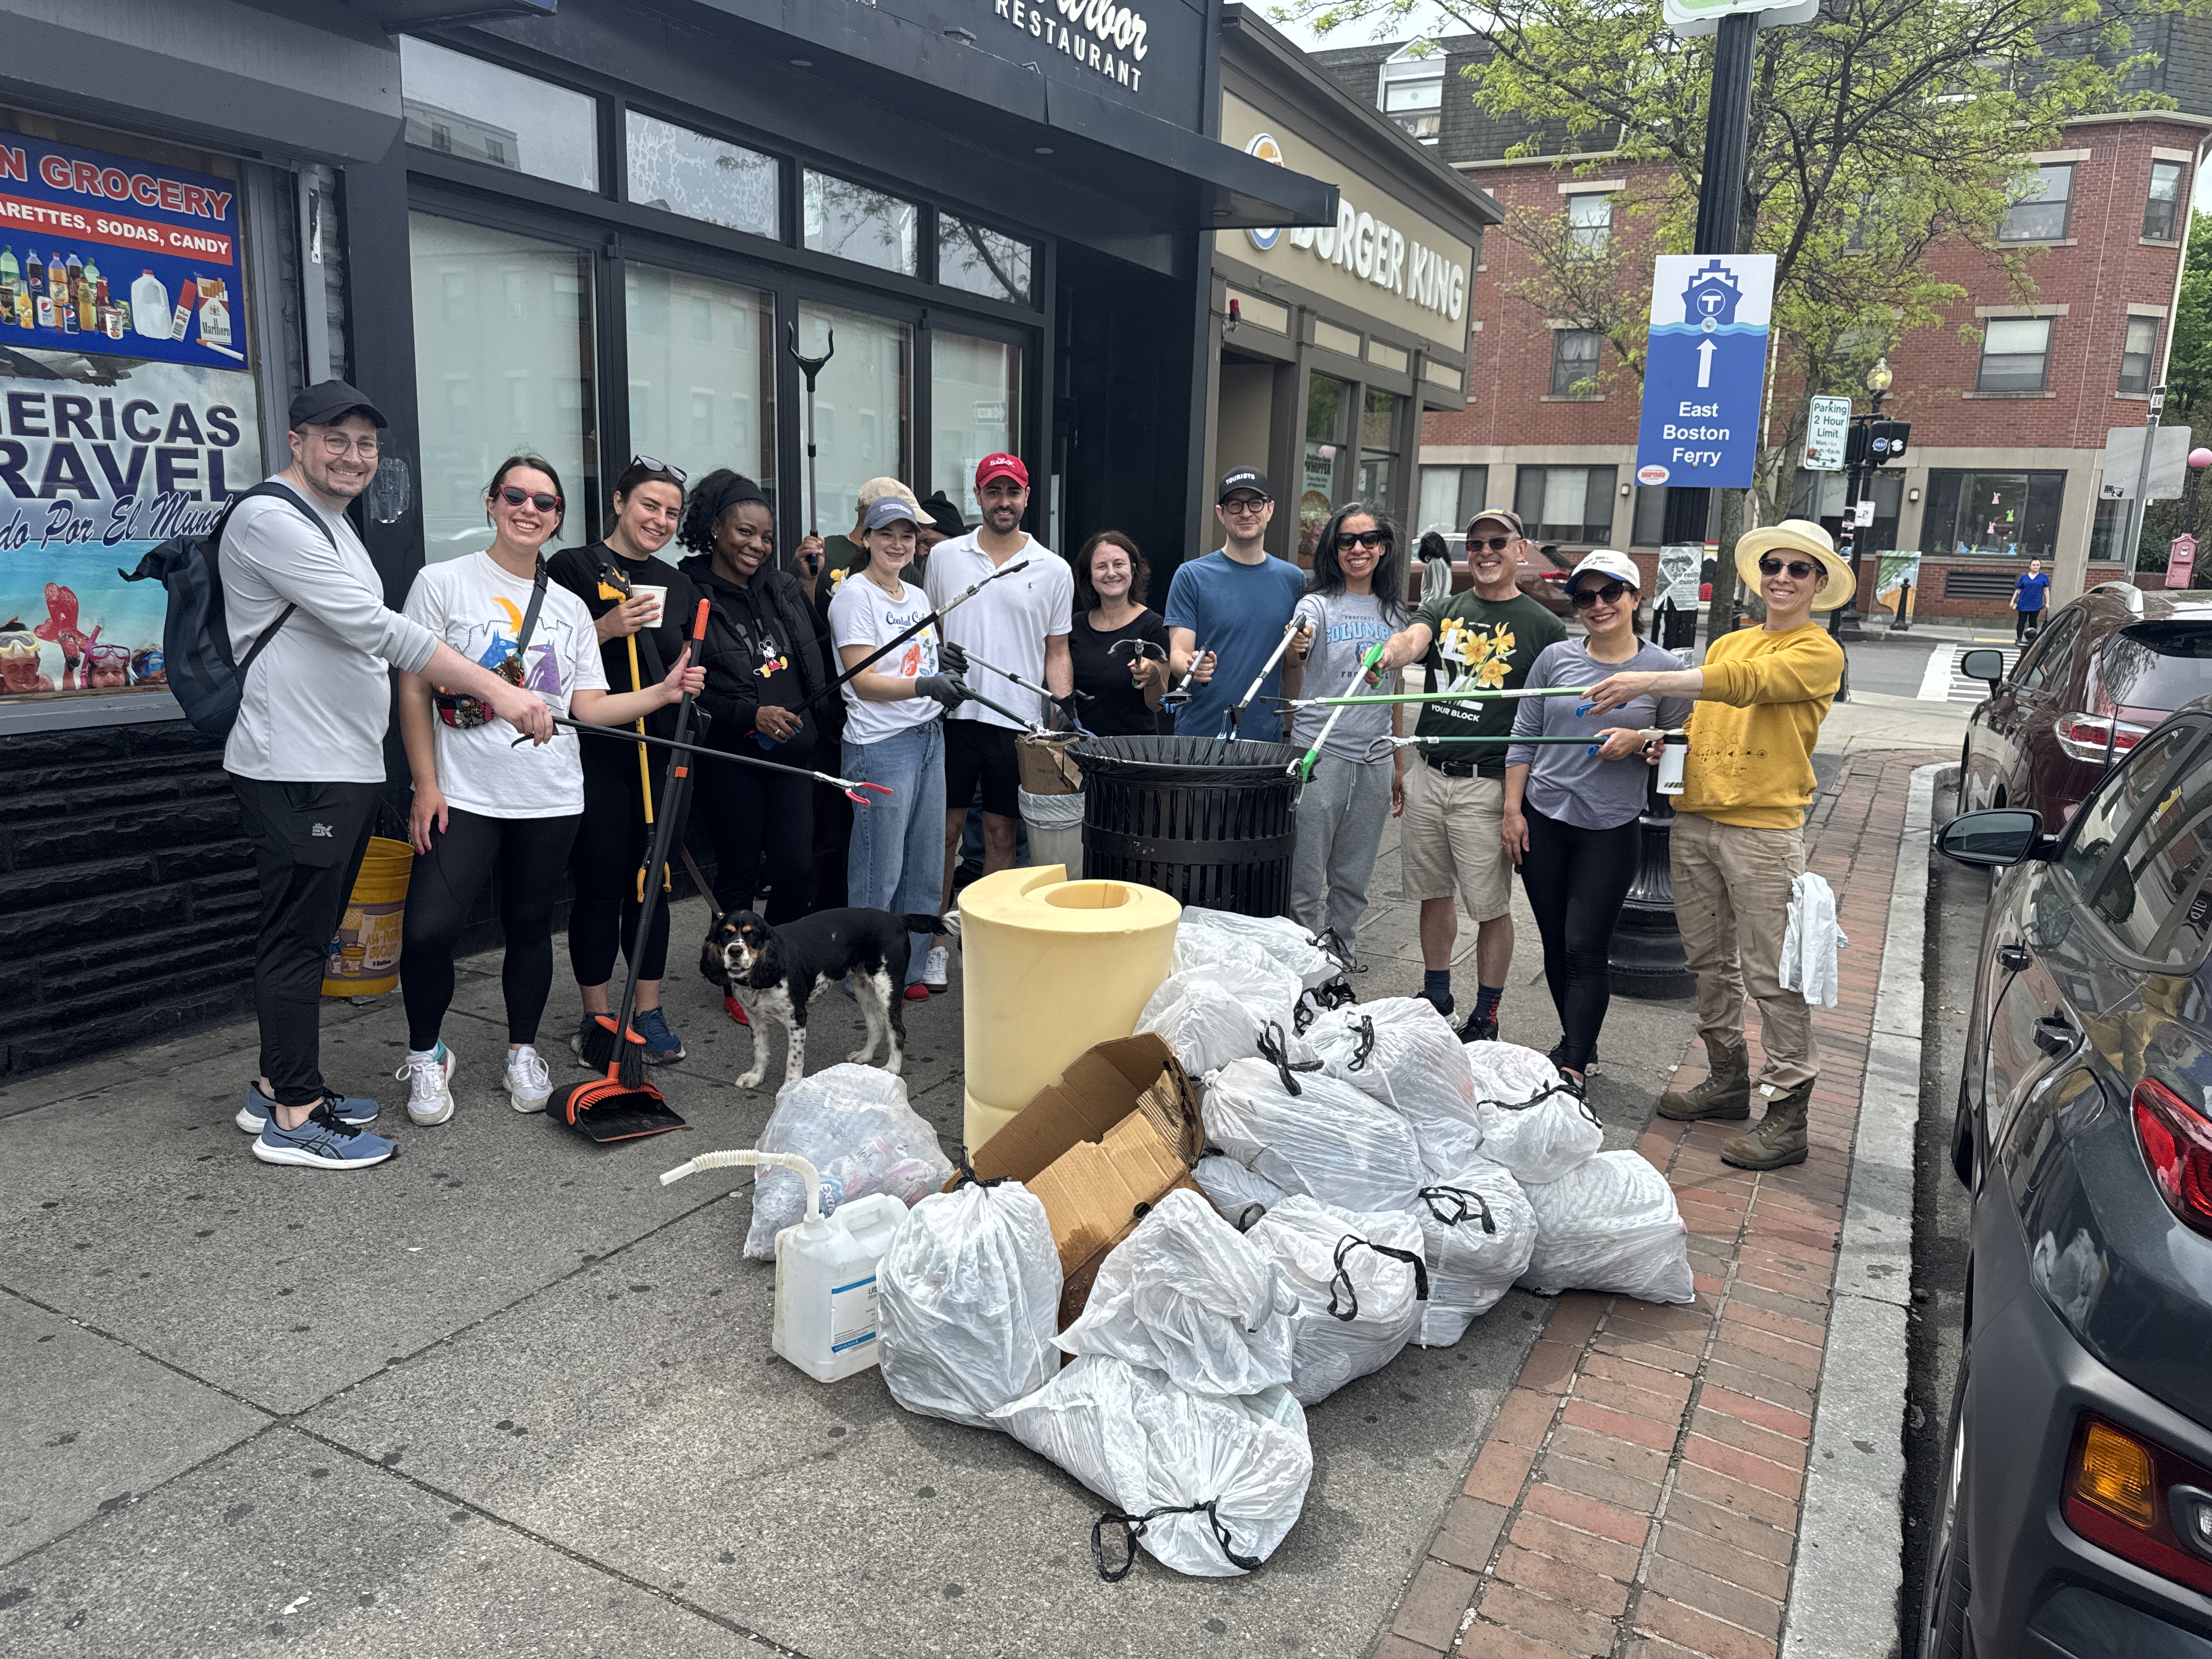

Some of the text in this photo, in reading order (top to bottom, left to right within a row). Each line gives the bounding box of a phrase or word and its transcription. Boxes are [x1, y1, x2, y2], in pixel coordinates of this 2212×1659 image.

[995, 0, 1141, 92] RESTAURANT
[40, 155, 232, 221] GROCERY
[97, 219, 165, 246] SODAS,
[170, 233, 229, 255] CANDY
[1406, 240, 1464, 321] KING
[1702, 295, 1721, 312] T
[202, 318, 230, 337] Marlboro
[1679, 402, 1718, 417] East
[1814, 403, 1847, 415] Parking
[0, 391, 240, 447] ERICAS
[1814, 415, 1844, 426] 2 Hour
[1663, 425, 1730, 440] Boston
[1817, 428, 1838, 438] Limit
[1672, 448, 1722, 467] Ferry
[1305, 461, 1331, 476] WHOPPER
[1226, 473, 1255, 486] TOURISTS
[41, 499, 94, 550] Por
[103, 495, 143, 548] El
[149, 492, 234, 540] Mund
[886, 611, 911, 627] Coastal
[1326, 622, 1393, 645] COLUMB
[1431, 704, 1480, 722] YOUR BLOCK
